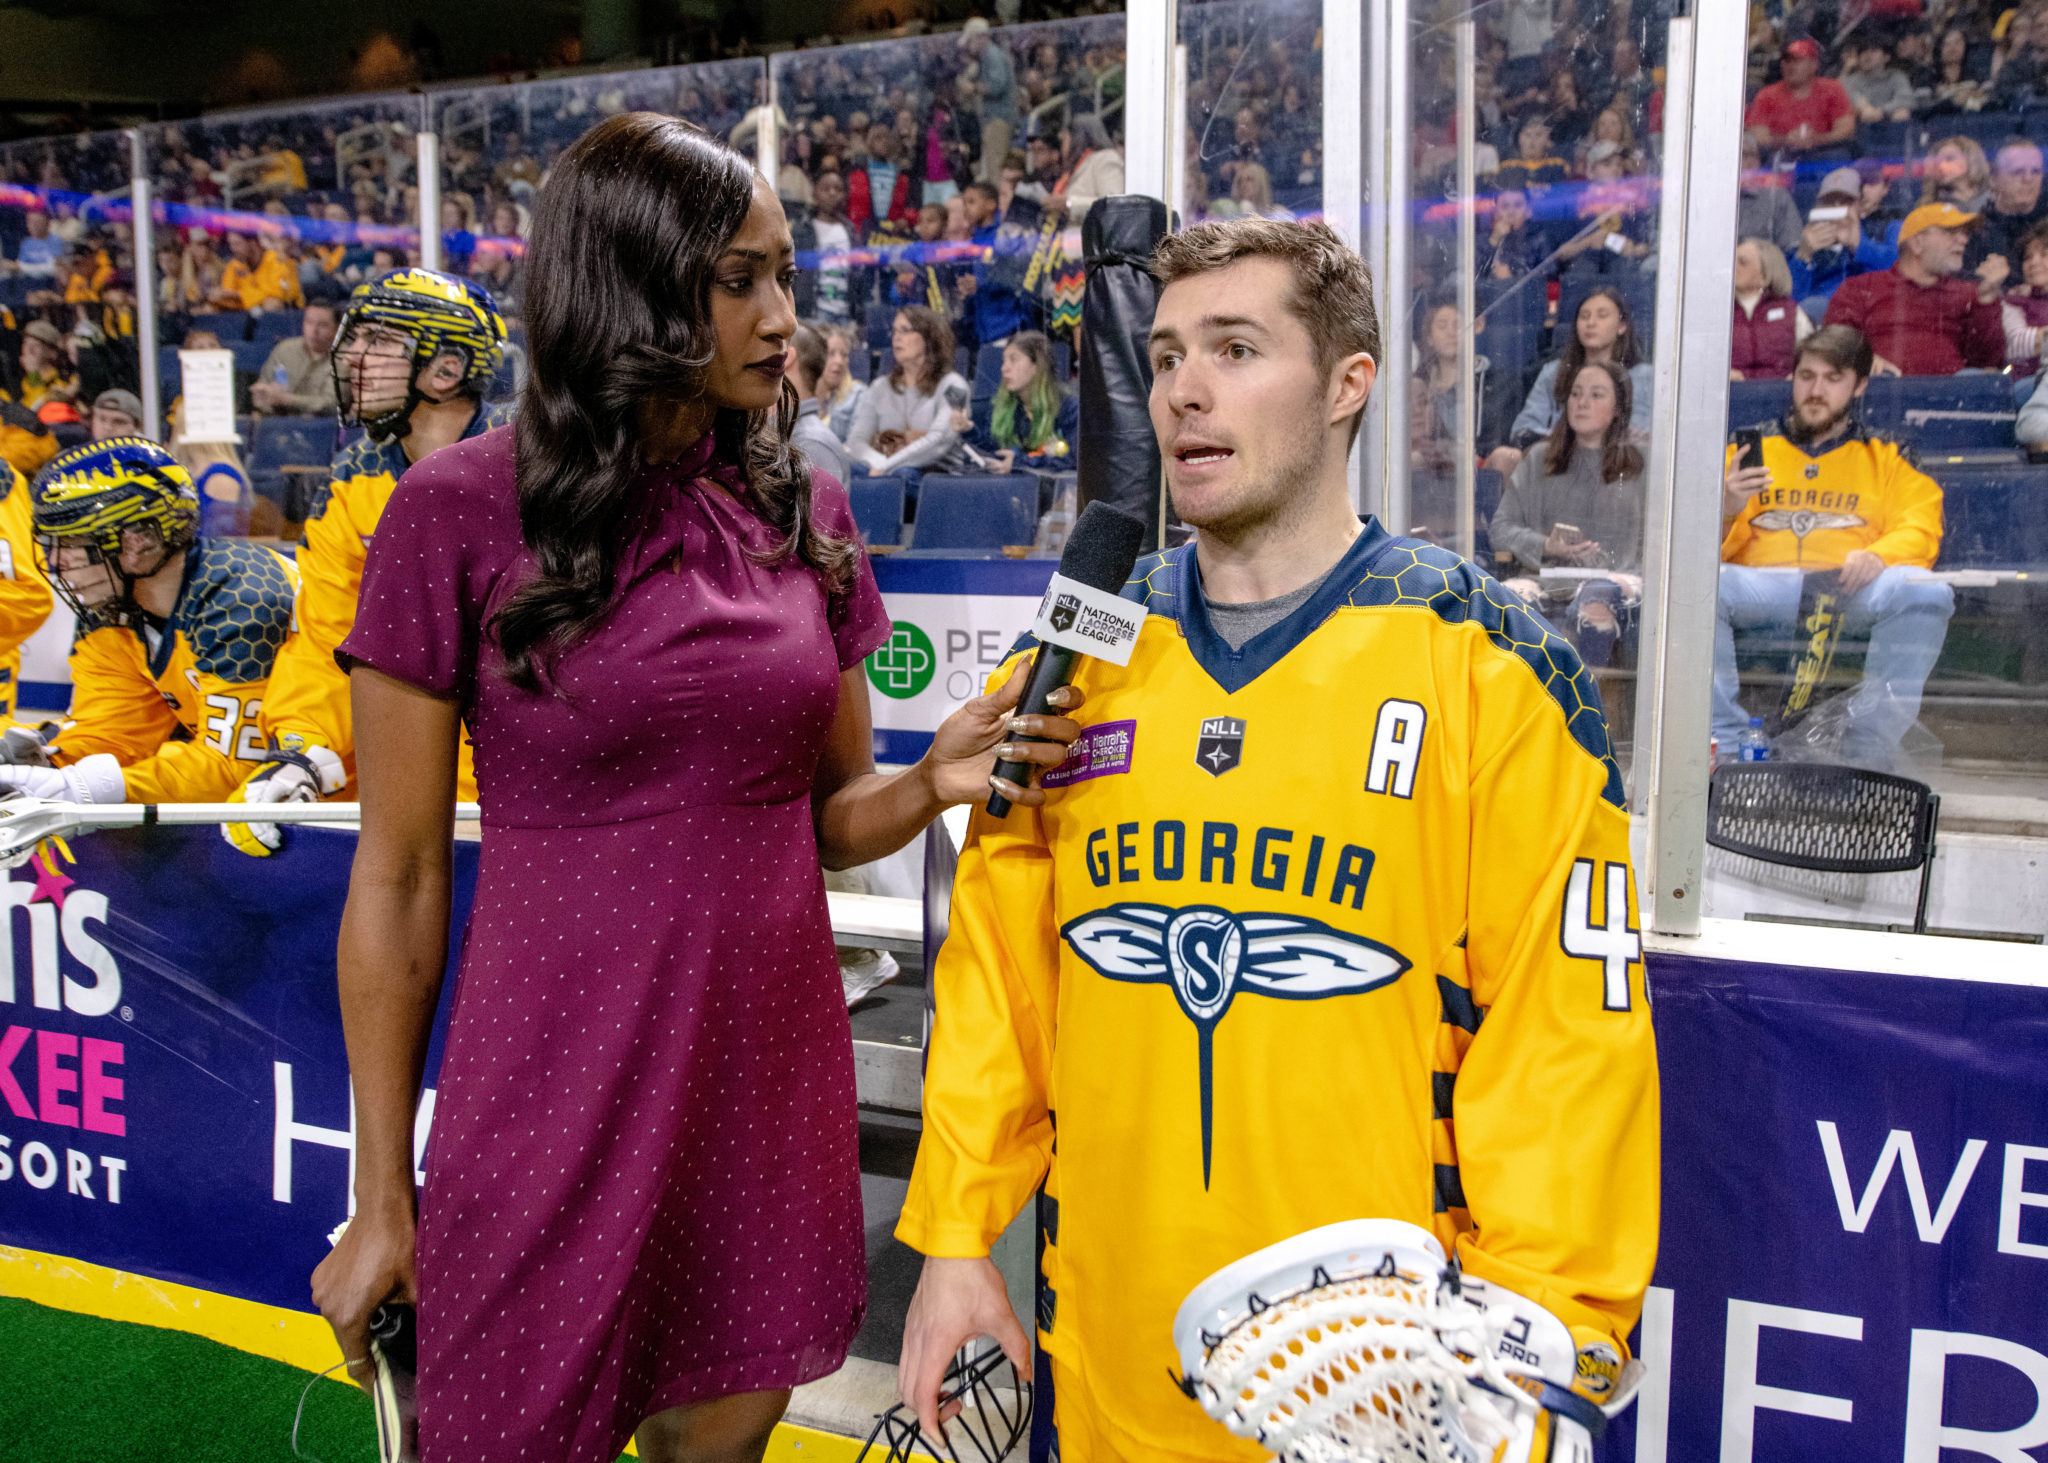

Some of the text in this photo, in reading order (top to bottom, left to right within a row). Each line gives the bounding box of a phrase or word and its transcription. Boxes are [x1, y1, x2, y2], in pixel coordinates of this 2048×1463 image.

[1759, 488, 1860, 511] GEORGIA
[1057, 595, 1078, 610] NLL
[1079, 614, 1135, 642] LACROSSE
[1082, 605, 1136, 633] NATIONAL
[946, 629, 1027, 665] PE
[1075, 624, 1118, 647] LEAGUE
[204, 694, 268, 761] 32
[1203, 720, 1242, 735] NLL
[1092, 744, 1127, 757] CHEROKEE
[1364, 697, 1427, 800] A
[1086, 820, 1376, 911] GEORGIA
